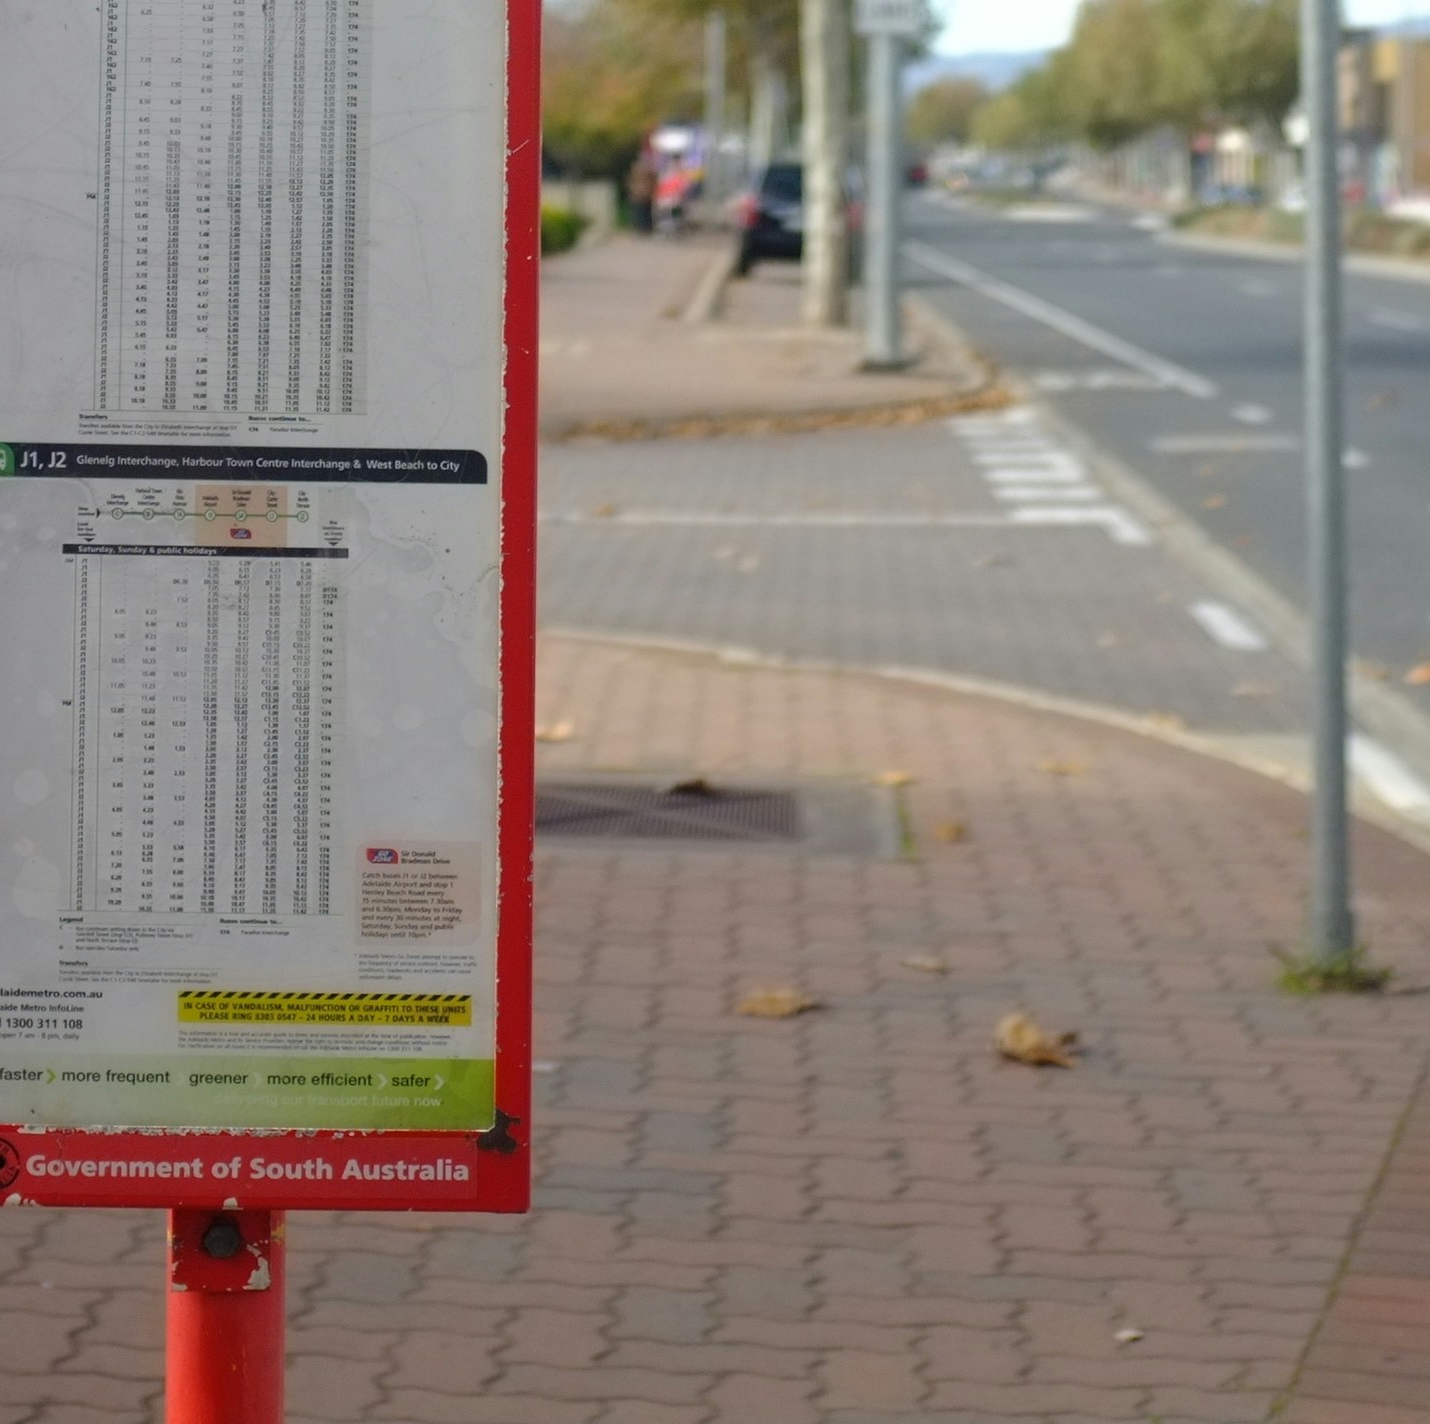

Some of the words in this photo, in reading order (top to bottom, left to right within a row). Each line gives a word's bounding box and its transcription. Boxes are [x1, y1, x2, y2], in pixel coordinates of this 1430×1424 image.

[20, 453, 44, 471] J1,
[48, 453, 66, 468] J2
[76, 456, 115, 470] Glenelg
[117, 456, 179, 470] Interchange,
[182, 457, 223, 468] Harbour
[227, 457, 253, 468] Town
[256, 458, 289, 468] Centre
[291, 458, 350, 472] Interchange
[353, 459, 361, 469] &
[366, 459, 393, 470] West
[395, 459, 424, 470] Beach
[426, 460, 438, 470] to
[440, 460, 460, 474] City
[78, 546, 115, 555] Saturday,
[118, 547, 146, 555] Sunday
[157, 547, 181, 556] public
[183, 547, 217, 556] holidays
[21, 1004, 47, 1012] Metro
[49, 1004, 84, 1012] InfoLine
[232, 1004, 284, 1012] VANDALISM,
[287, 1004, 347, 1012] MALFUNCTION
[363, 1005, 399, 1013] GRAFFITI
[199, 1012, 229, 1020] PLEASE
[318, 1014, 348, 1022] HOURS
[349, 1014, 355, 1022] A
[358, 1014, 375, 1022] DAY
[418, 1015, 424, 1023] A
[427, 1015, 449, 1023] WEEK
[6, 1018, 33, 1028] 1300
[37, 1018, 57, 1029] 311
[63, 1018, 83, 1029] 108
[0, 1068, 44, 1081] faster
[62, 1072, 102, 1082] more
[106, 1070, 170, 1085] frequent
[189, 1074, 248, 1086] greener
[267, 1075, 307, 1085] more
[311, 1073, 372, 1086] efficient
[391, 1074, 430, 1087] safer
[282, 1097, 303, 1105] our
[308, 1095, 368, 1107] transport
[373, 1096, 410, 1106] future
[414, 1098, 441, 1106] now
[26, 1154, 203, 1179] Government
[211, 1155, 241, 1179] of
[250, 1155, 332, 1180] South
[342, 1156, 469, 1181] Australia
